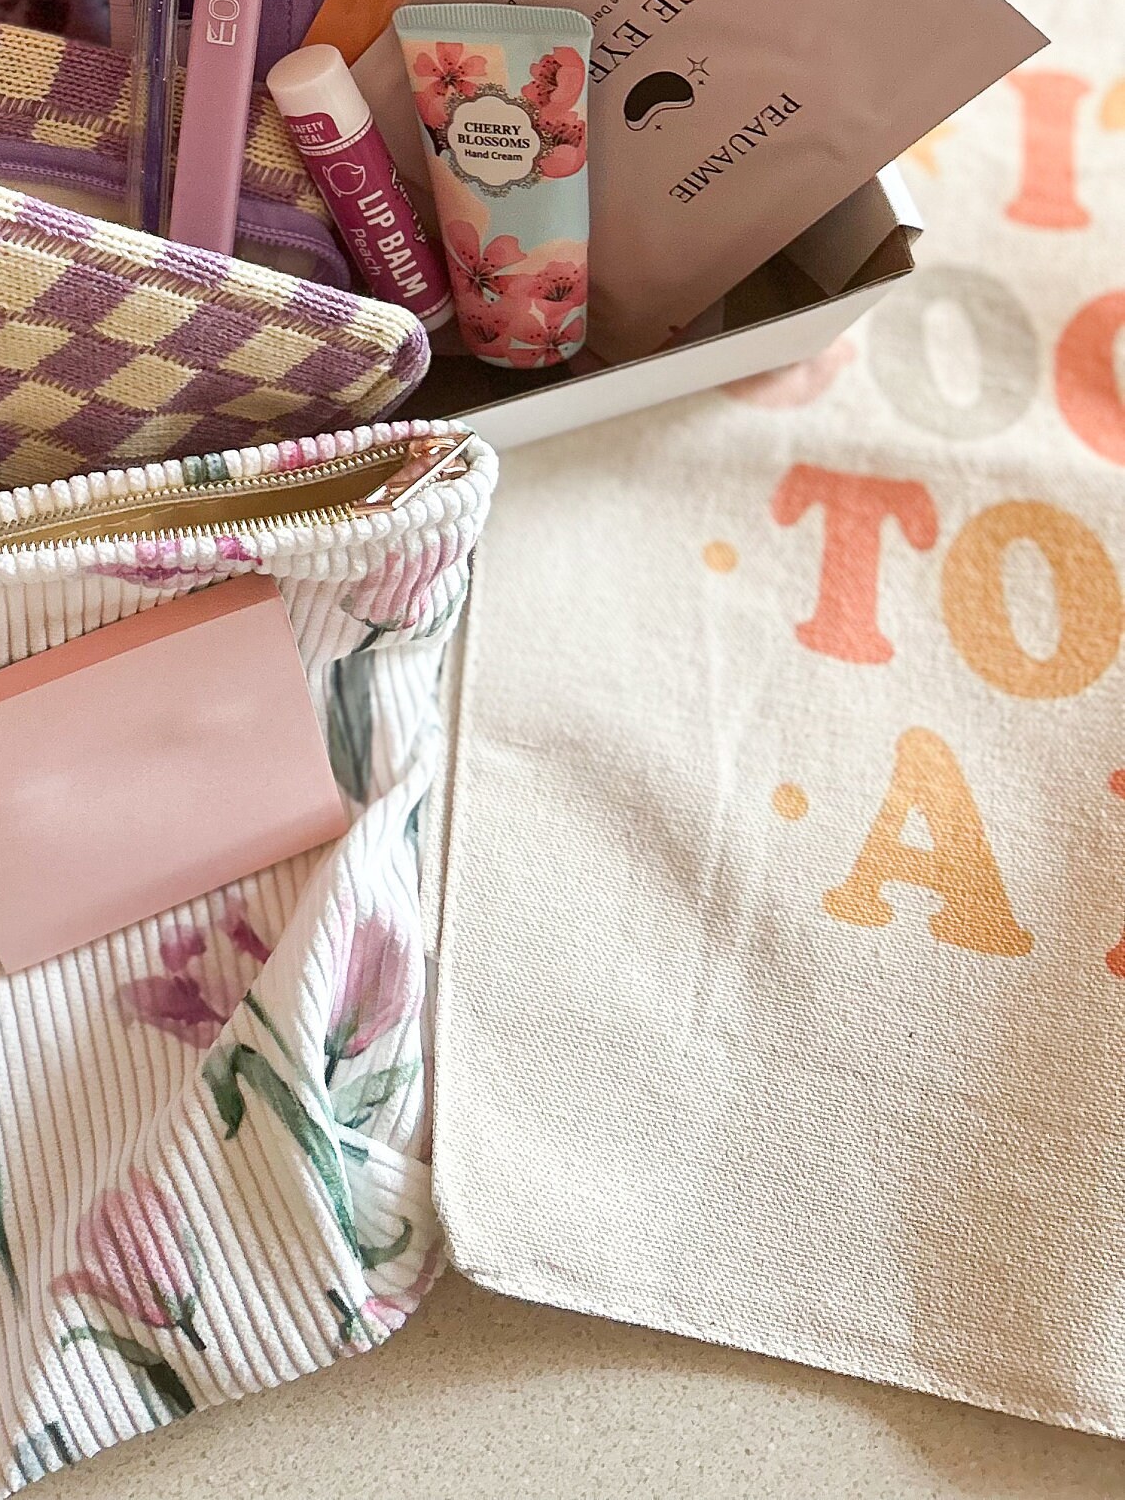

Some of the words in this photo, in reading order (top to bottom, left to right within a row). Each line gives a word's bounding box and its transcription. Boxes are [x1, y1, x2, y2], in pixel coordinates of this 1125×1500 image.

[464, 122, 522, 135] CHERRY
[299, 134, 325, 144] SEAL
[457, 134, 530, 148] BLOSSOMS
[465, 149, 489, 159] Hand
[491, 152, 522, 161] Cream
[669, 92, 803, 204] PEAUAMIE
[357, 189, 396, 228] LIP
[377, 231, 428, 299] BALM
[349, 228, 383, 276] Peach
